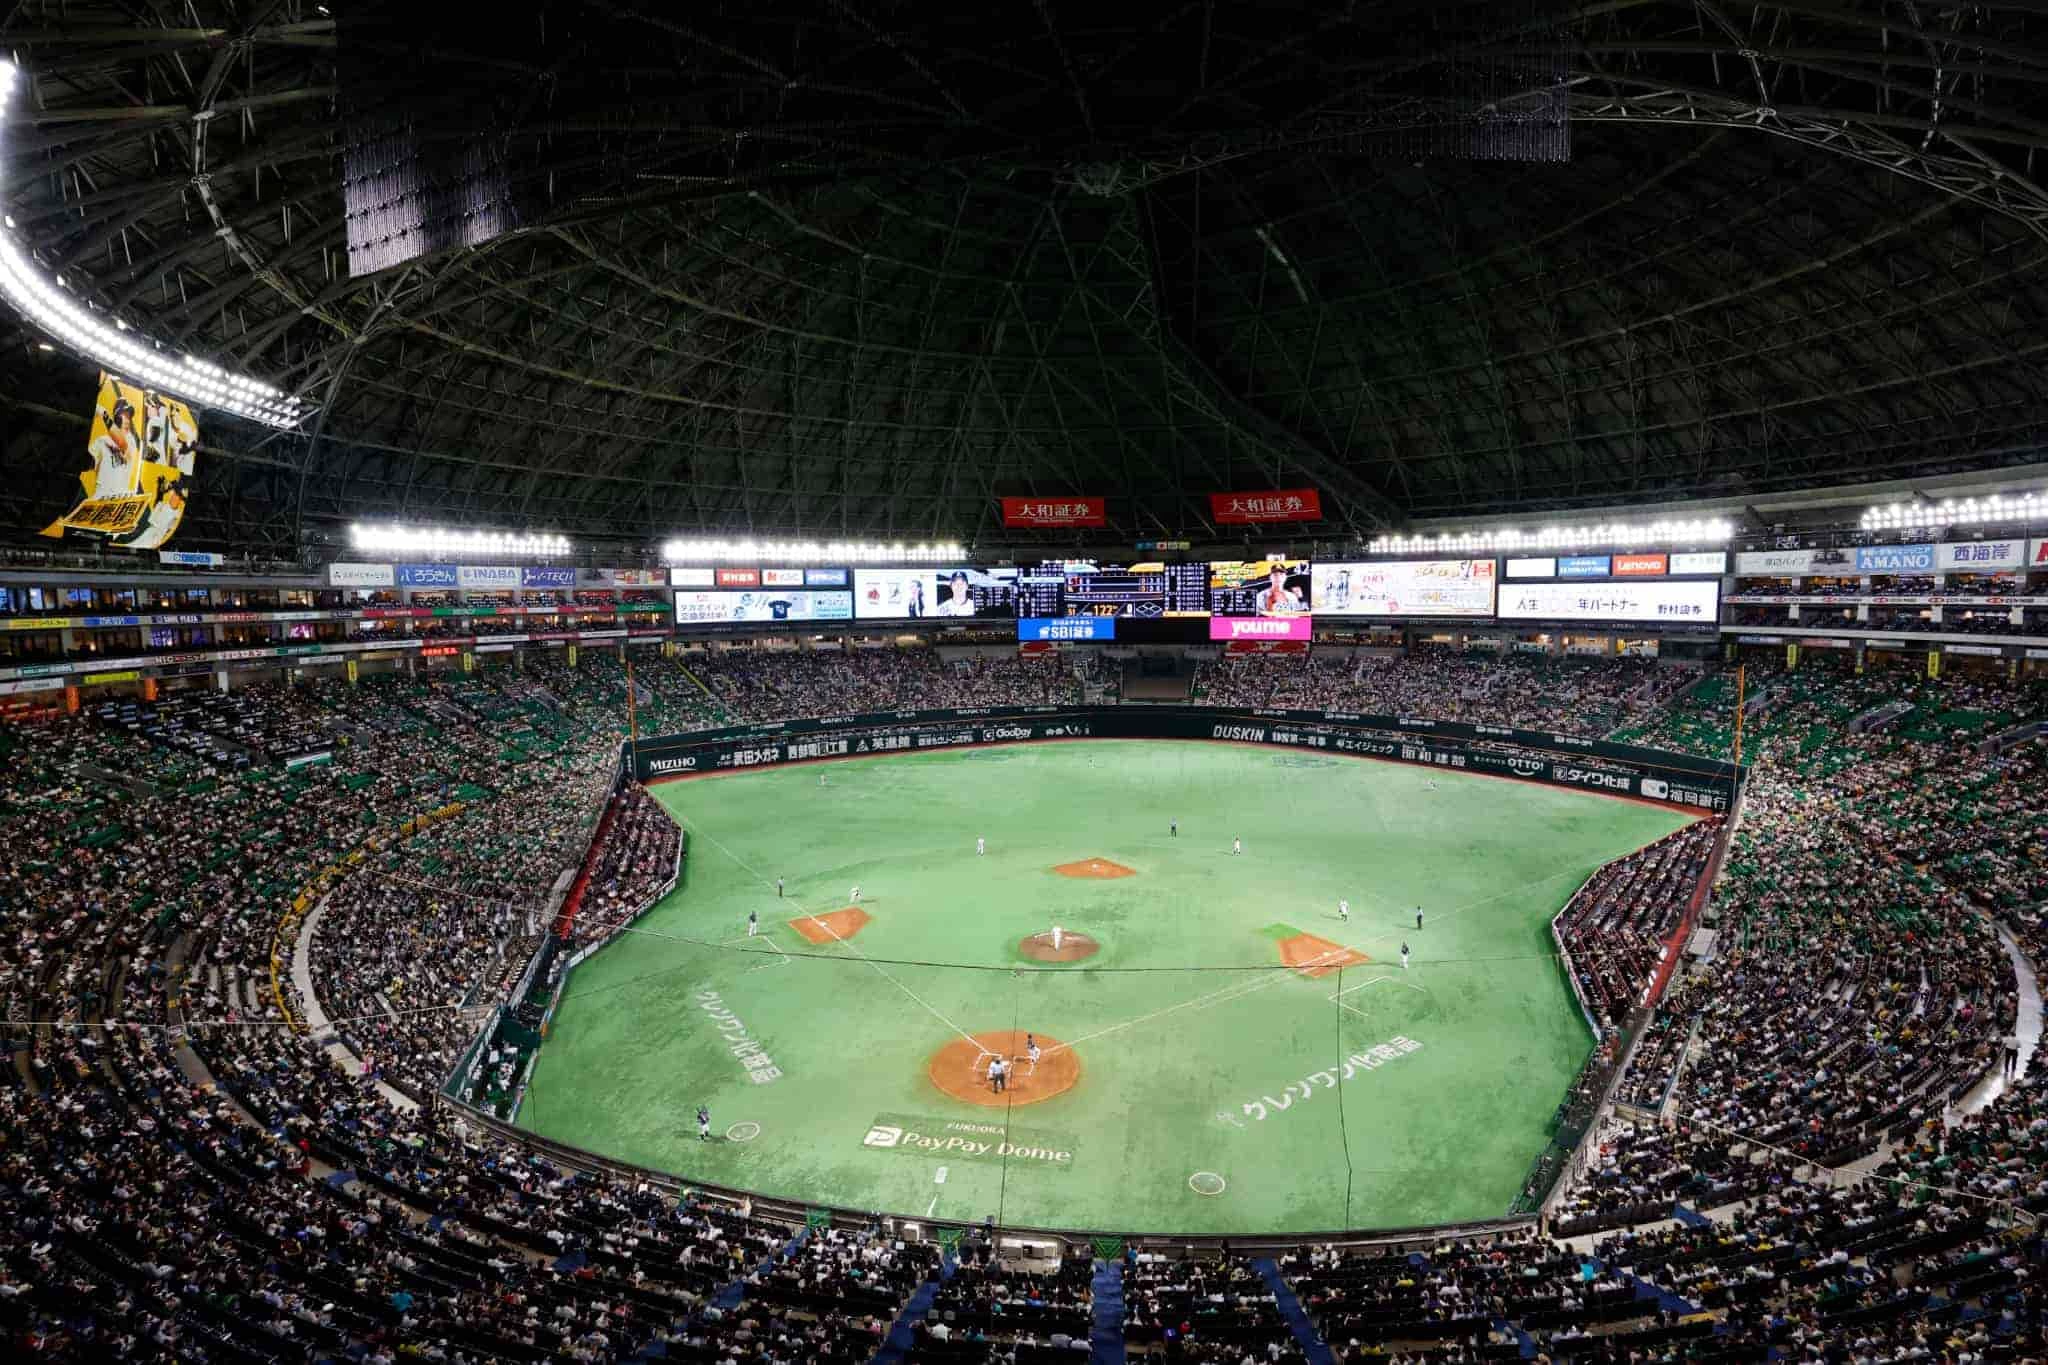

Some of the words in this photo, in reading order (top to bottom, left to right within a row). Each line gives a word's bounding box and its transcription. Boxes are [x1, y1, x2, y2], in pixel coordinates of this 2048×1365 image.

[1953, 544, 2010, 561] 西海岸
[1617, 560, 1662, 570] Lenovo
[1861, 554, 1930, 569] AMANO
[1231, 621, 1290, 637] youme
[996, 727, 1032, 738] GooDay
[1213, 724, 1264, 742] DUSKIN
[650, 757, 696, 770] MIZUHO
[902, 1132, 992, 1156] PayPay
[997, 1144, 1071, 1161] Dome
